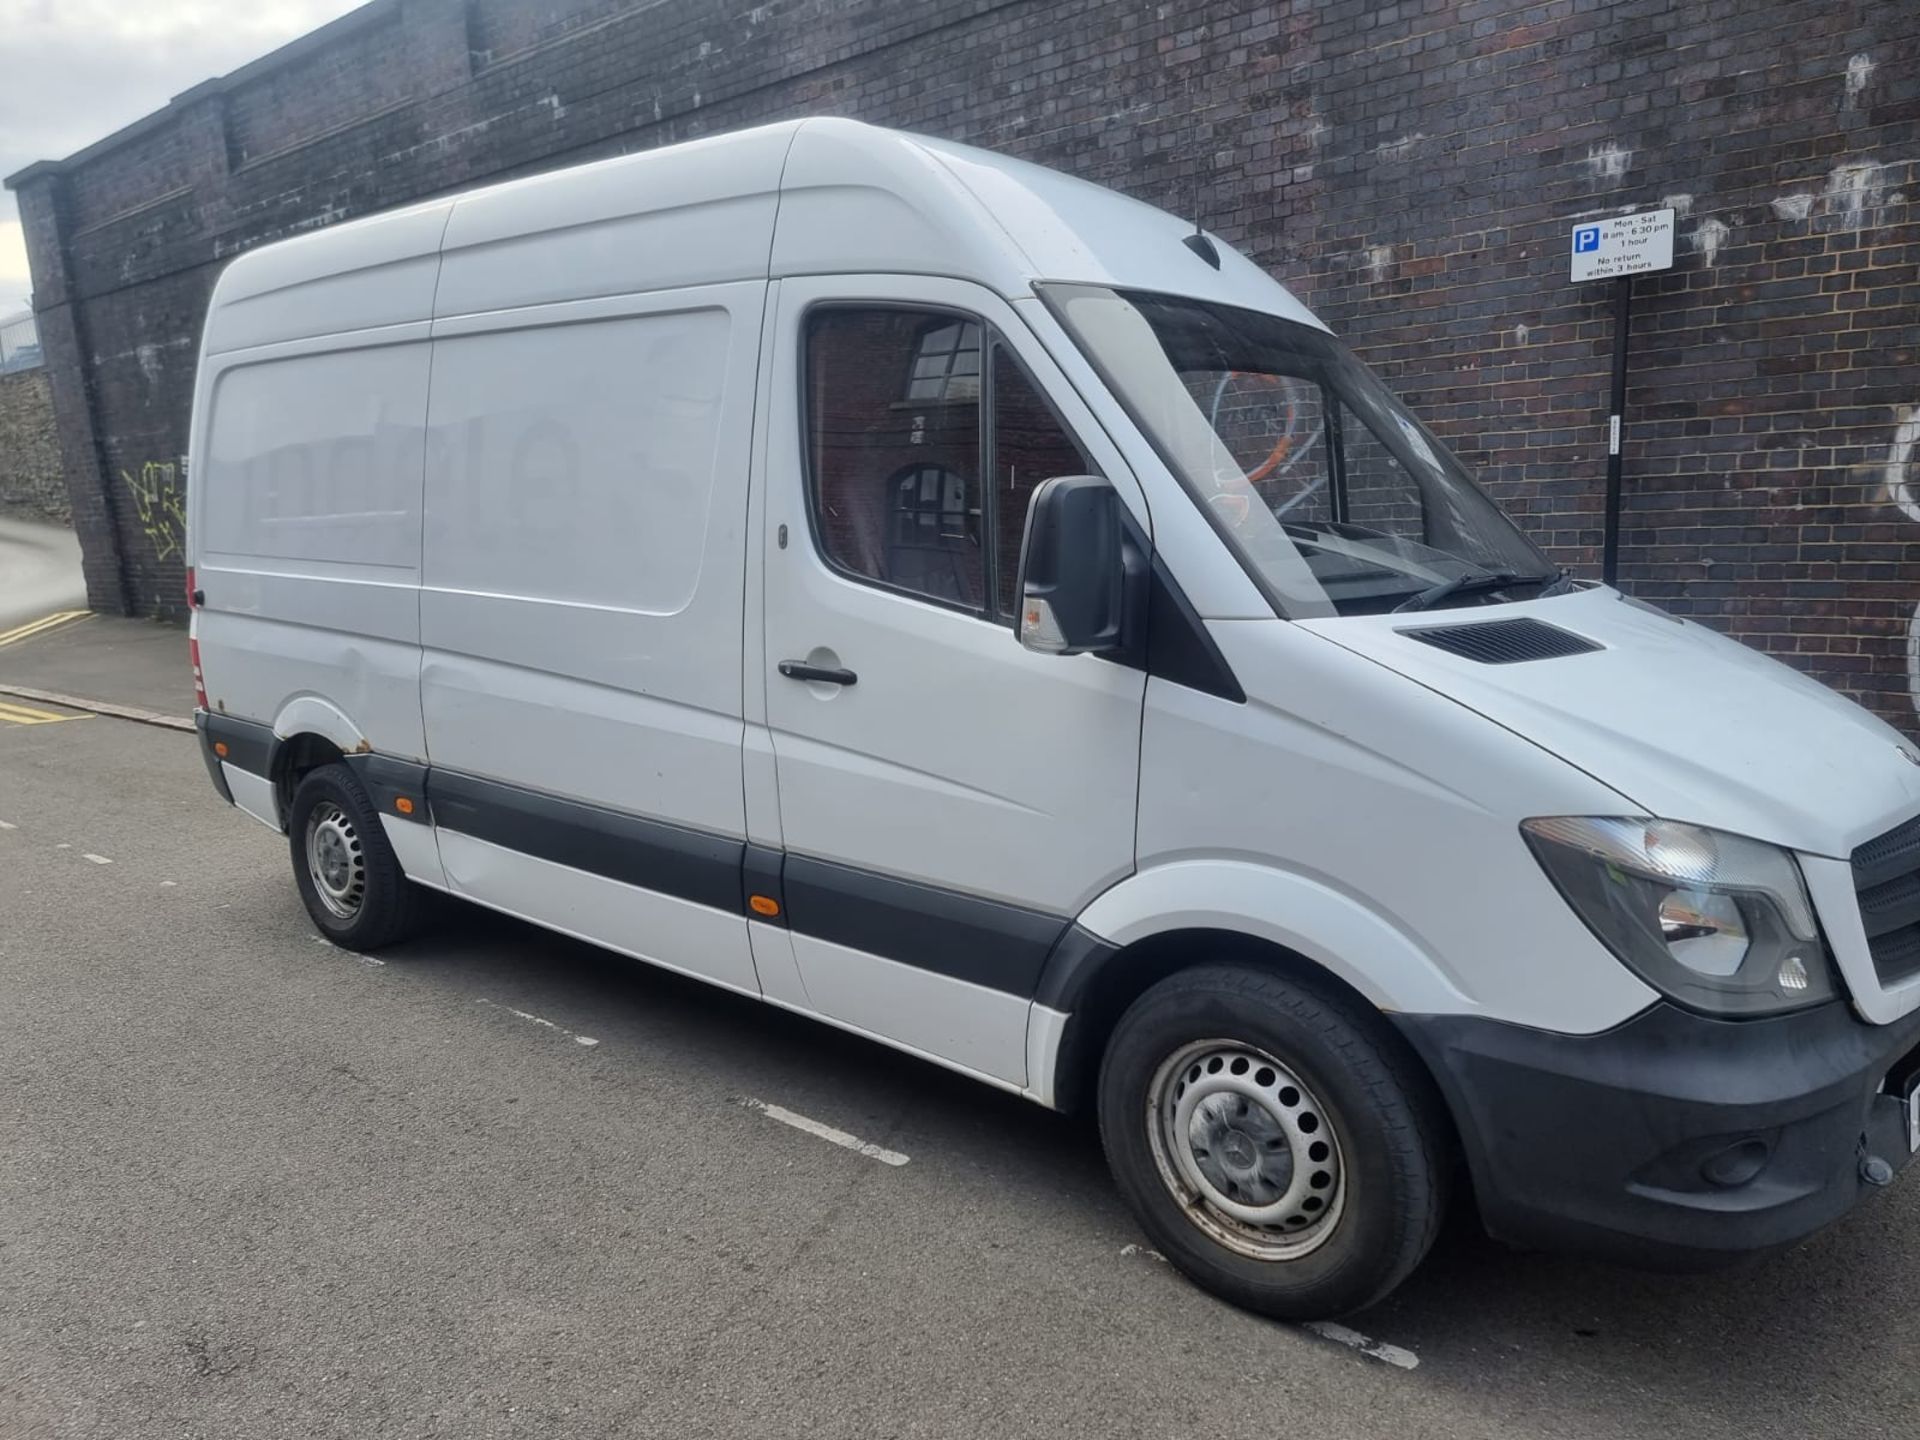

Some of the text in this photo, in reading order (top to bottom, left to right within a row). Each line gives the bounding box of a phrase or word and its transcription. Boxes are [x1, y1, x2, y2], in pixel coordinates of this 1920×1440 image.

[1614, 220, 1632, 228] Mon
[1641, 215, 1656, 224] Sat
[1631, 225, 1652, 235] 630
[1654, 224, 1669, 233] pm
[1579, 230, 1596, 251] P
[1628, 238, 1648, 246] hour
[1598, 253, 1641, 265] No return
[1586, 261, 1652, 277] within 3 hours
